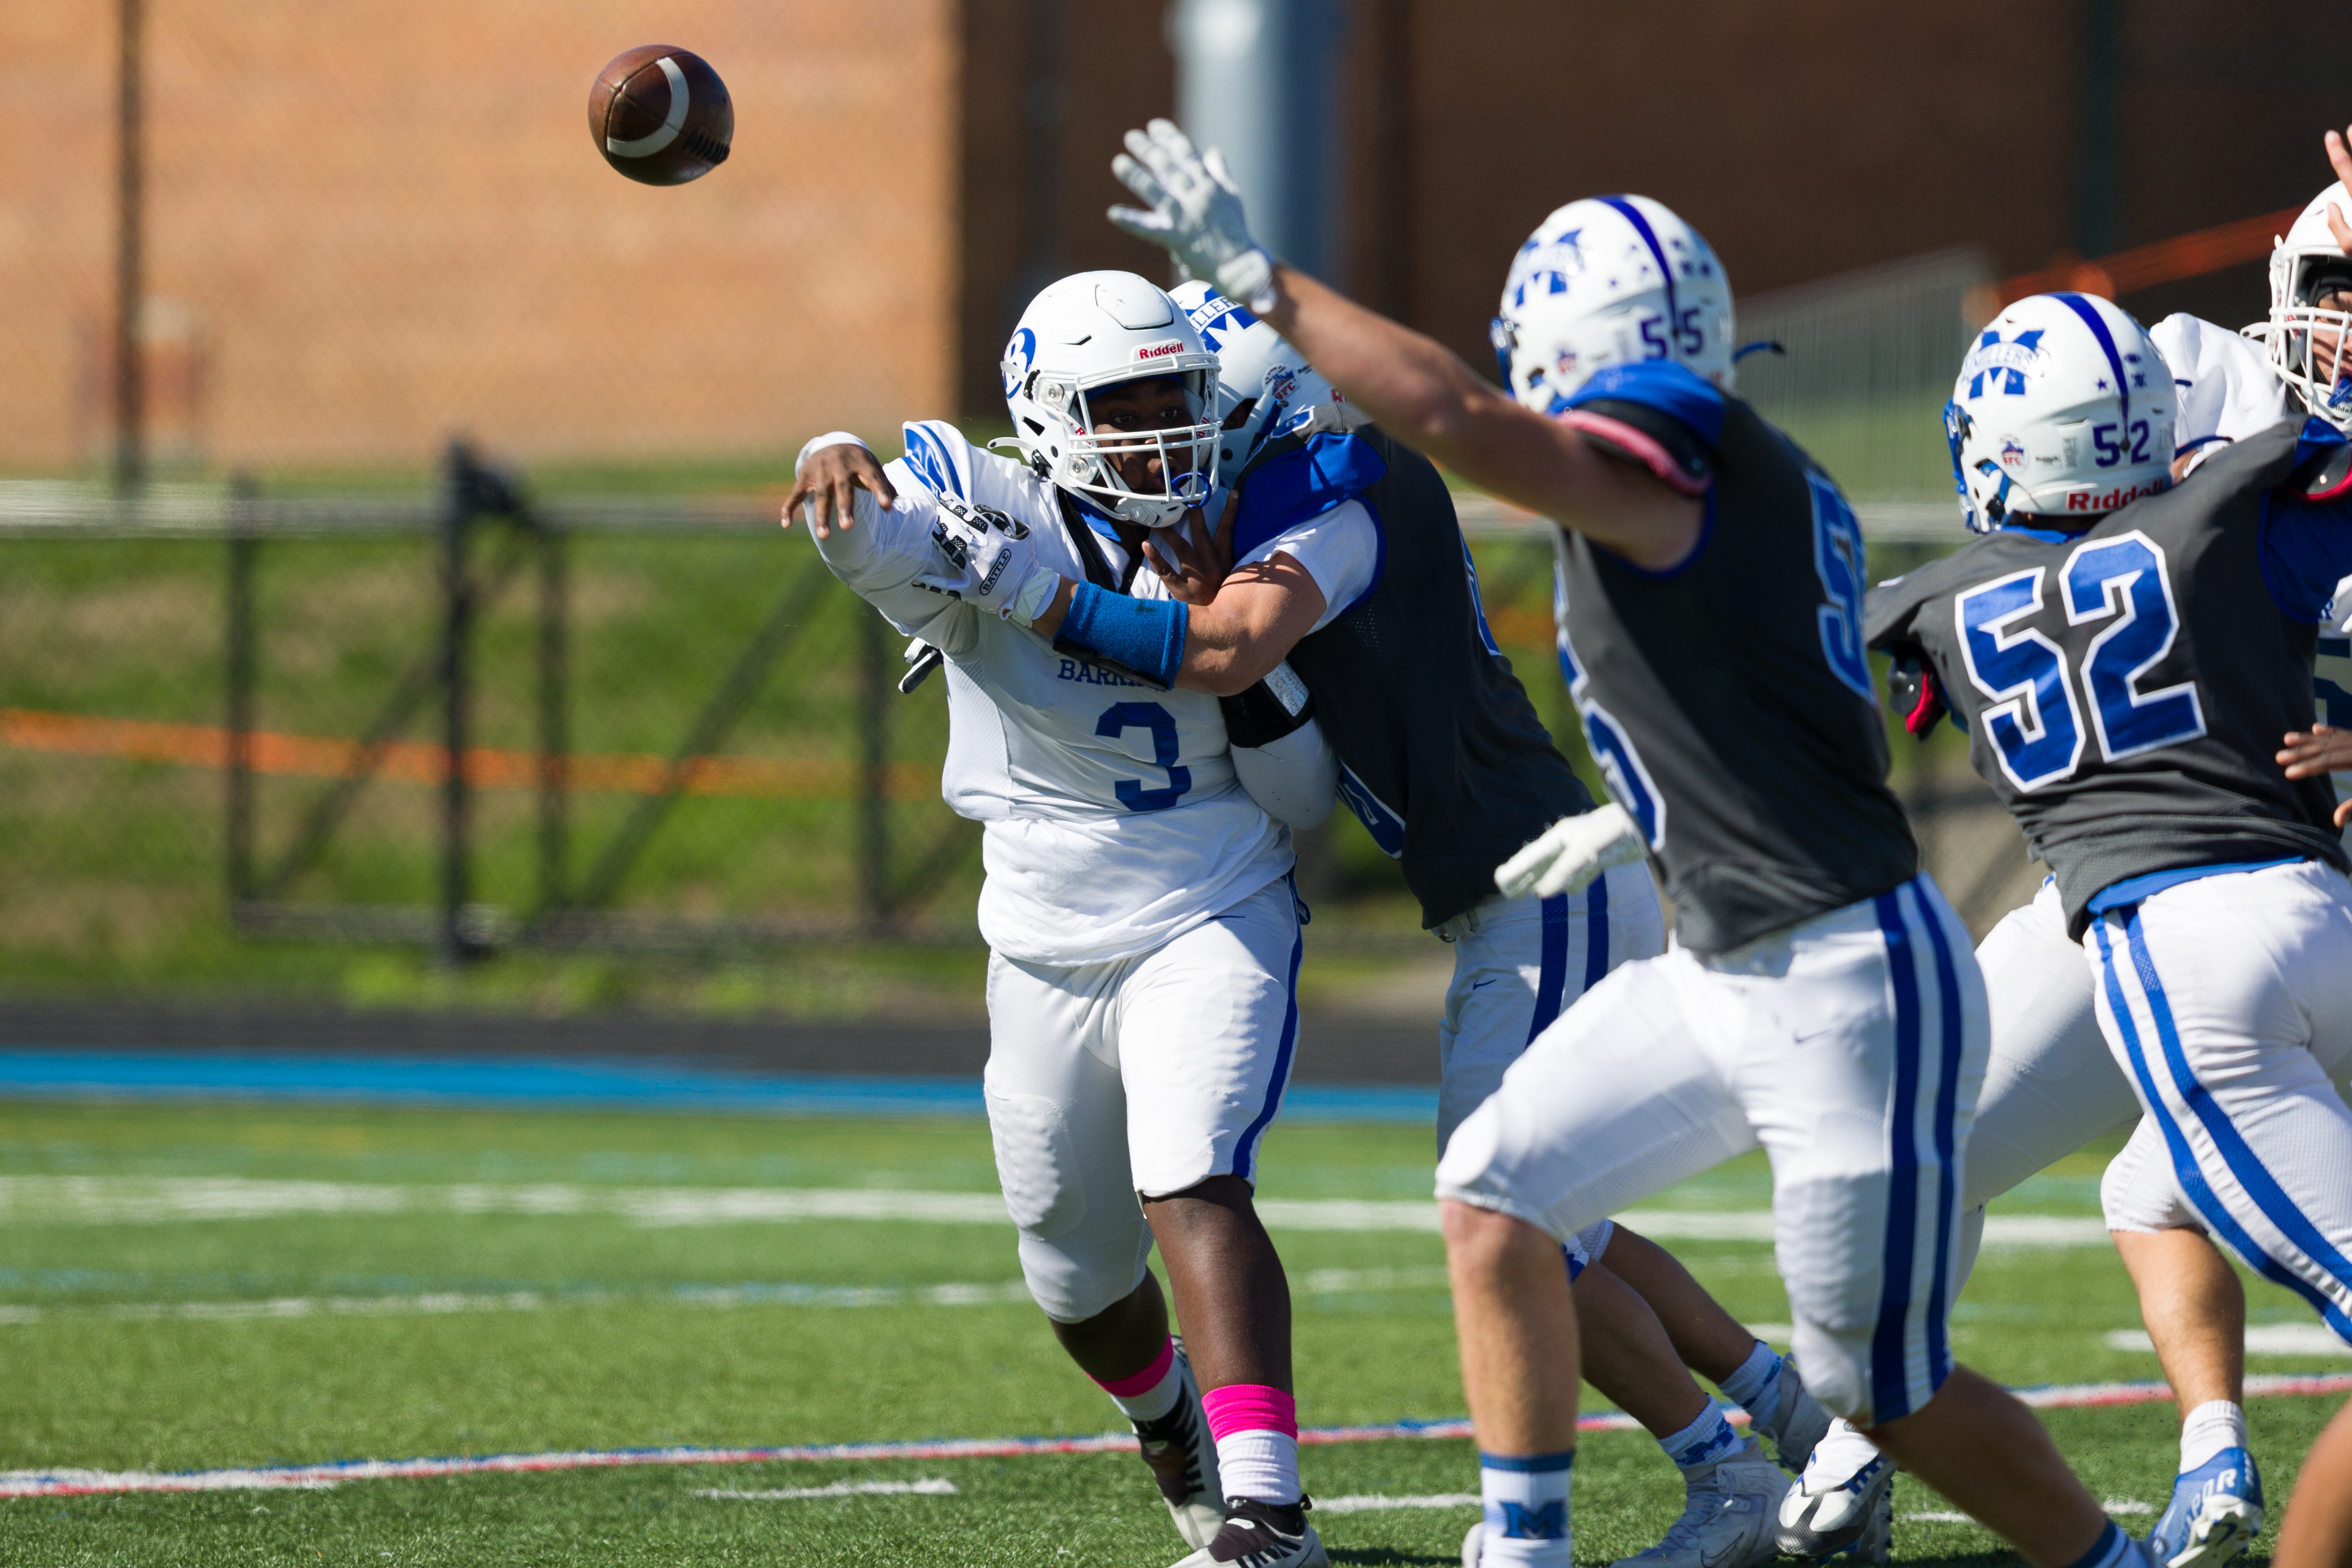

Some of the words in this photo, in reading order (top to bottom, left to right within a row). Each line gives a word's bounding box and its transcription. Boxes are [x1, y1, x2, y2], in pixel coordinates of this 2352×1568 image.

[1139, 342, 1184, 359] Riddell
[1640, 307, 1703, 358] 55
[2093, 420, 2150, 467] 52
[982, 552, 1010, 592] BATTLE
[1954, 529, 2208, 793] 52
[1094, 701, 1192, 810] 3
[1499, 1500, 1567, 1540] M
